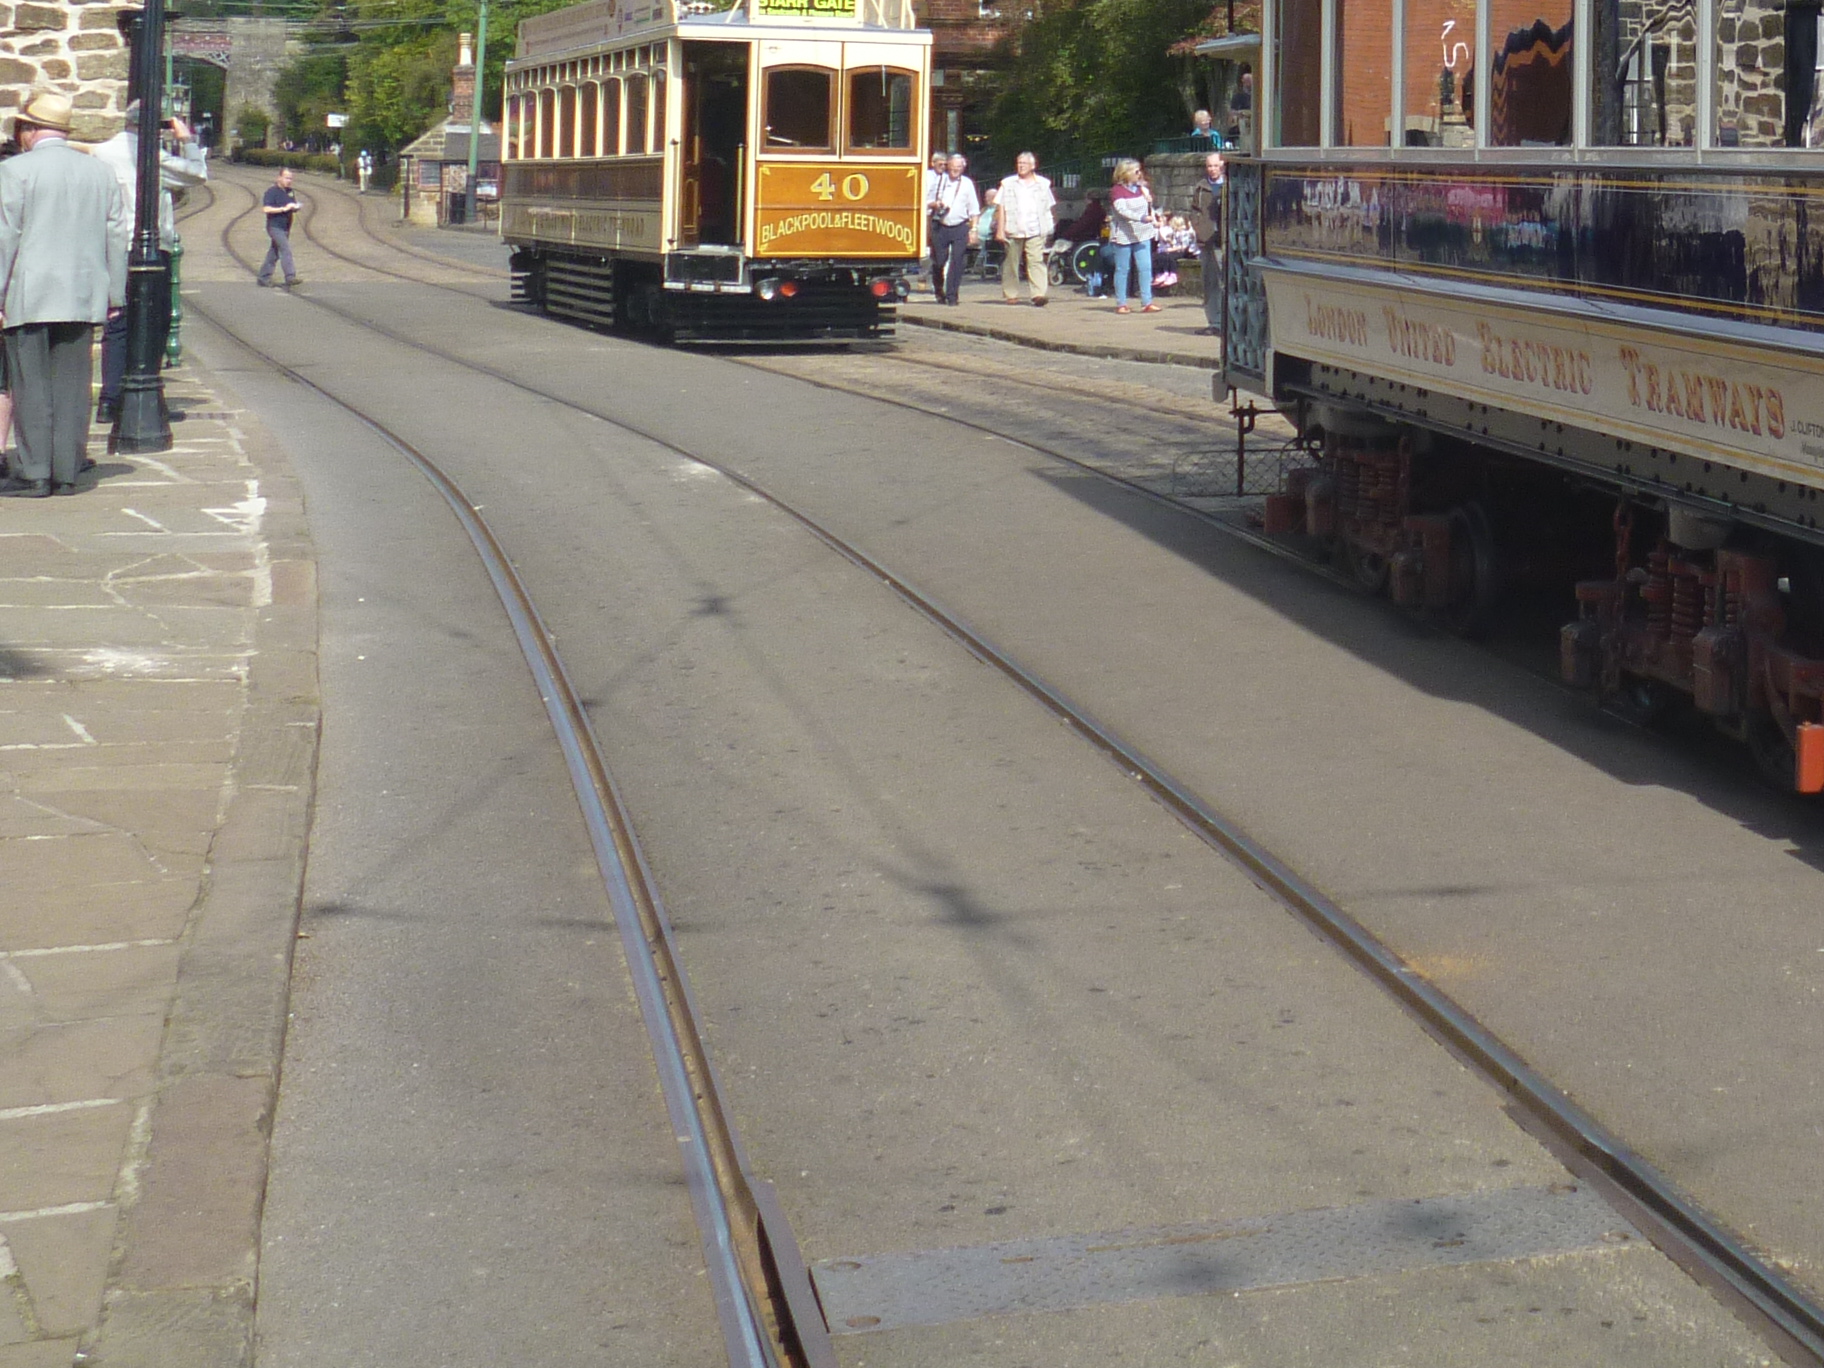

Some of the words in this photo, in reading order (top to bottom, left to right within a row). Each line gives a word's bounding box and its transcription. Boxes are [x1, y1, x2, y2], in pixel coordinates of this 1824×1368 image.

[810, 172, 869, 201] 40
[1476, 318, 1593, 395] ELECTRIC
[1619, 344, 1785, 439] TRAMWAYS
